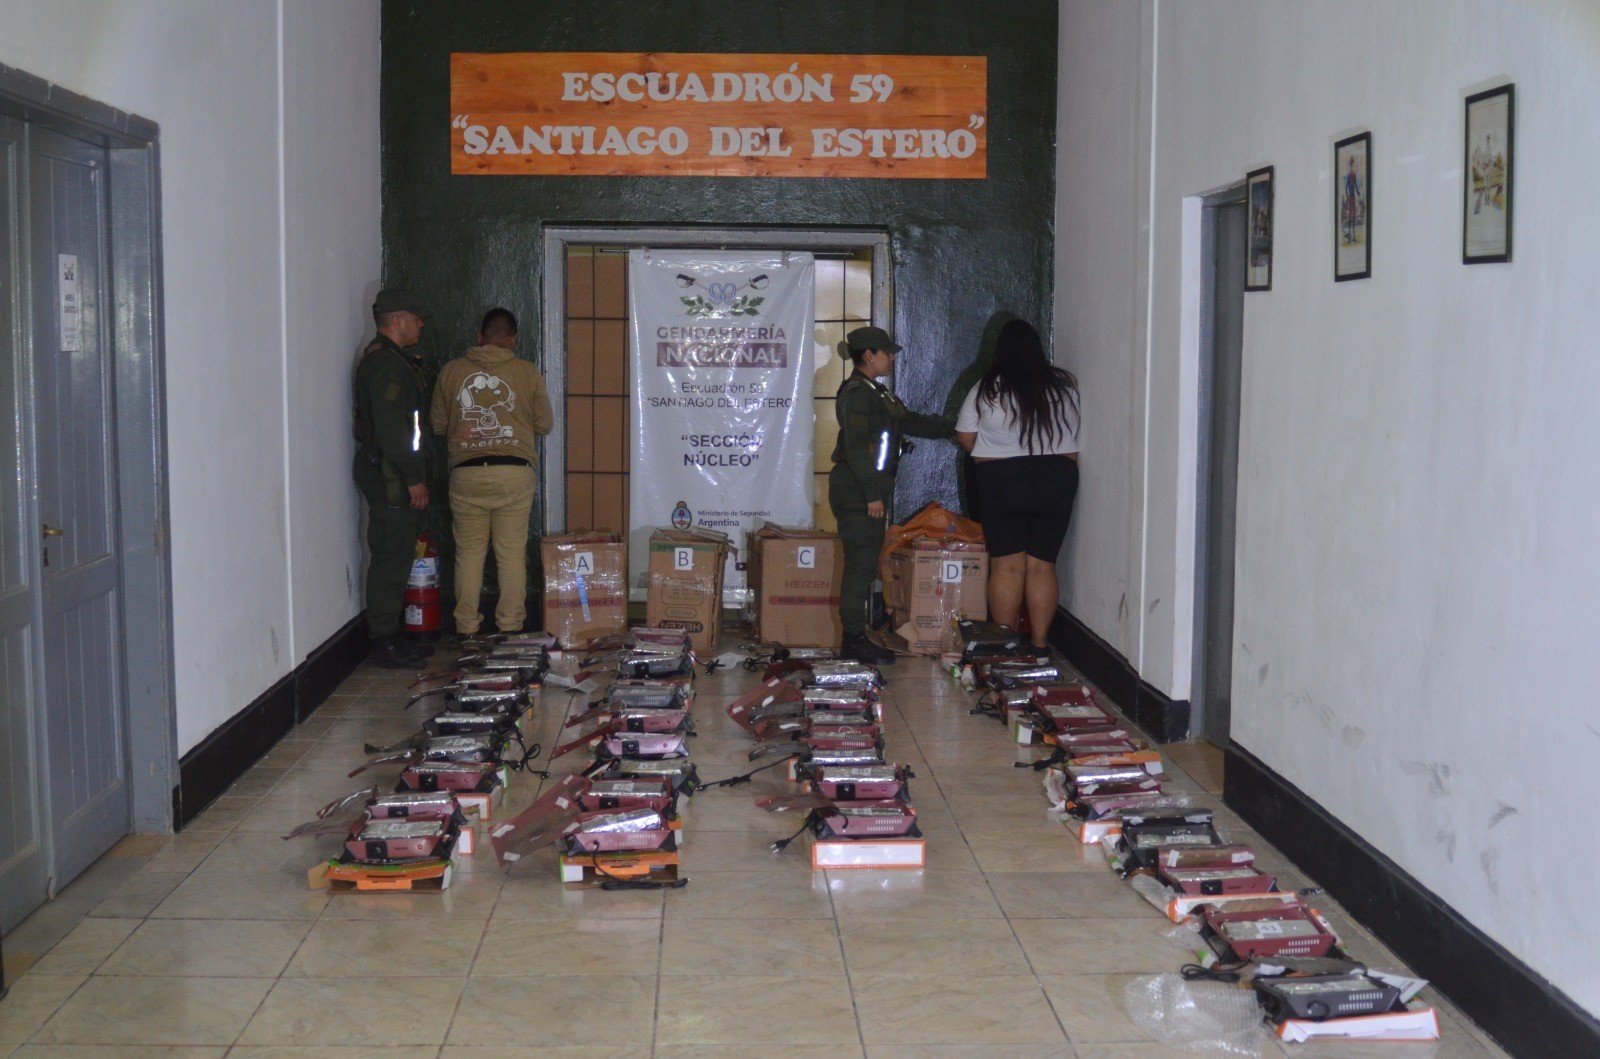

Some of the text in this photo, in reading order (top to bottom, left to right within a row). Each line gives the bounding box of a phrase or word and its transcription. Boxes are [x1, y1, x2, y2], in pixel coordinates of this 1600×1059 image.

[561, 63, 894, 104] ESCUADRÓN 59
[709, 127, 792, 157] DEL
[666, 346, 781, 364] NACIONAL
[681, 382, 745, 394] Escuadón
[683, 450, 759, 467] NÚCLEO”
[739, 510, 771, 518] Seguridad
[697, 518, 740, 528] Argentina
[576, 556, 590, 572] A
[677, 551, 690, 567] B
[799, 549, 812, 566] C
[946, 564, 959, 580] D
[785, 580, 830, 589] HEIZEN
